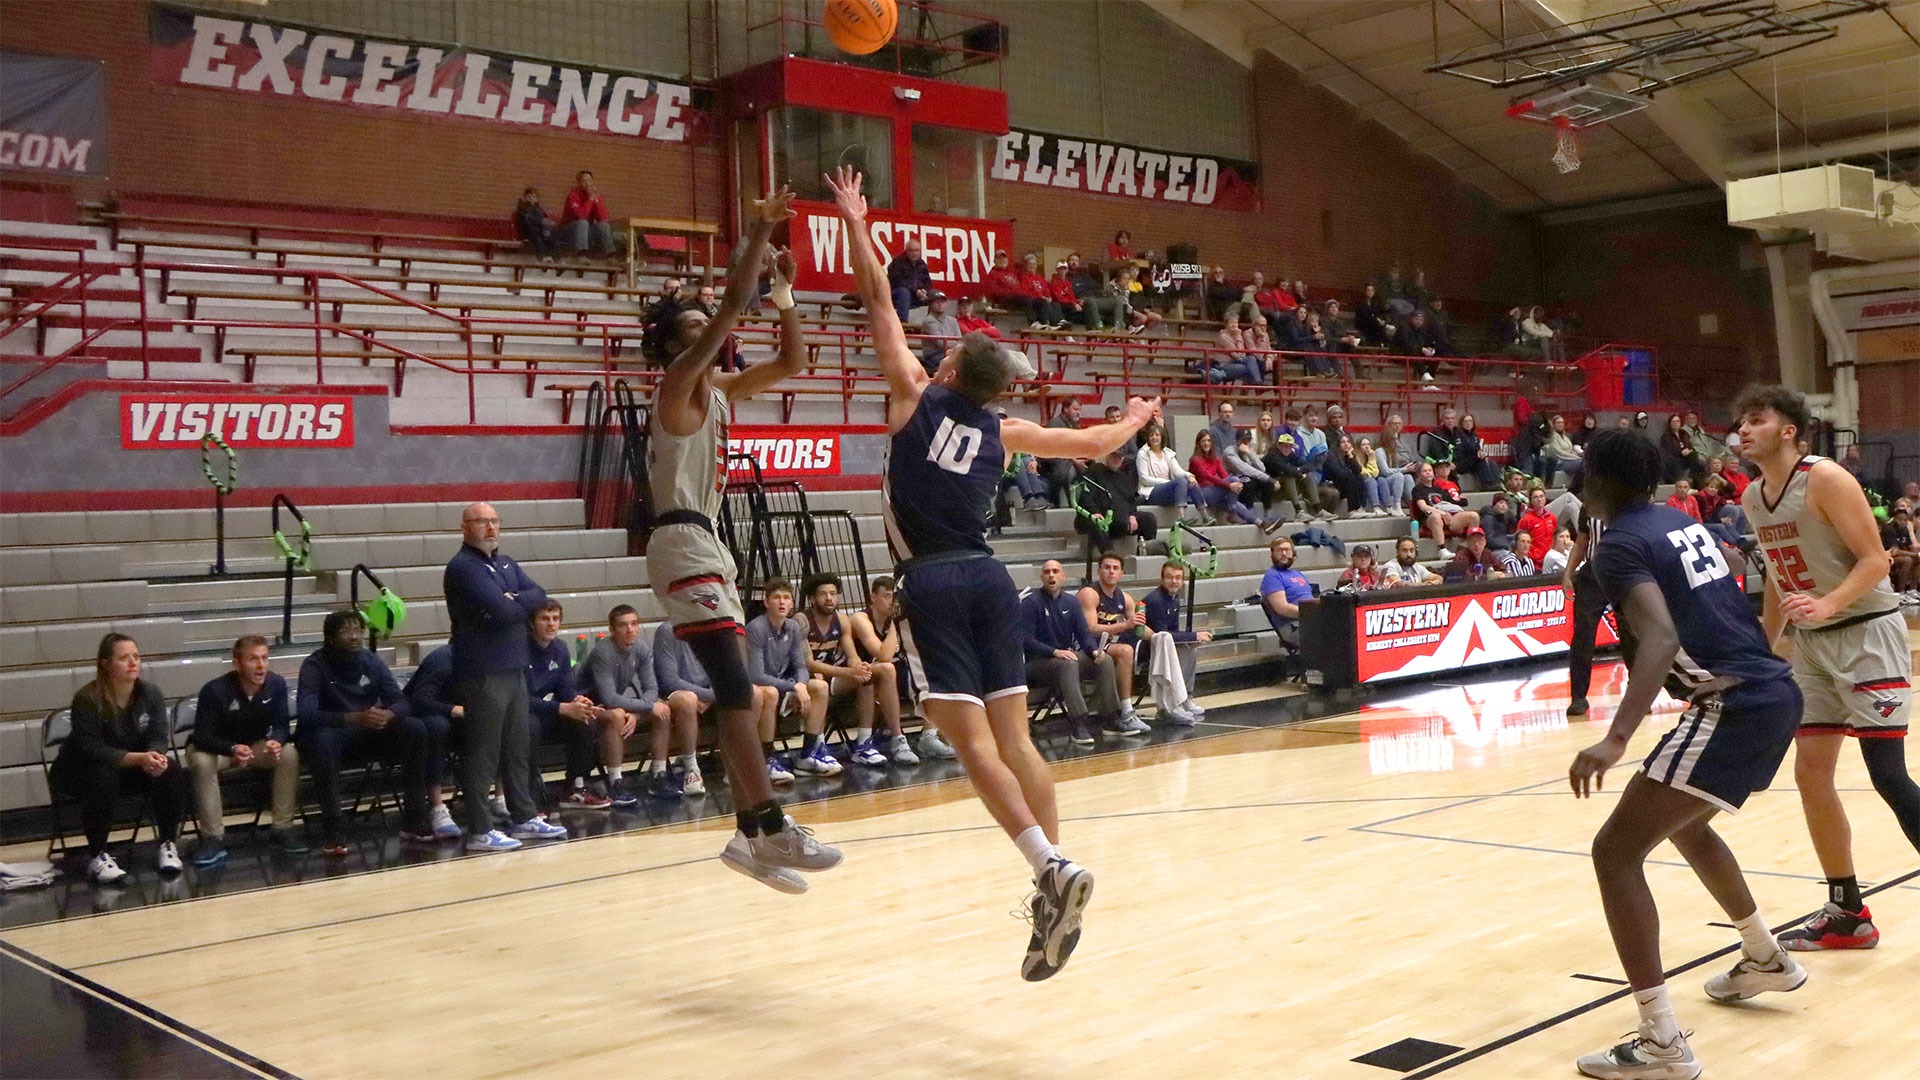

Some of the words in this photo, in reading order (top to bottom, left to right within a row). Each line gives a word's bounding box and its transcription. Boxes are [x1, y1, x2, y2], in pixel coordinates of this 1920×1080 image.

[180, 16, 691, 141] EXCELLENCE
[991, 131, 1219, 204] ELEVATED
[130, 402, 345, 441] VISITORS
[926, 416, 982, 475] 10
[1666, 523, 1730, 590] 23
[1766, 545, 1816, 592] 32
[1365, 601, 1450, 636] WESTERN
[1492, 589, 1565, 620] COLORADO
